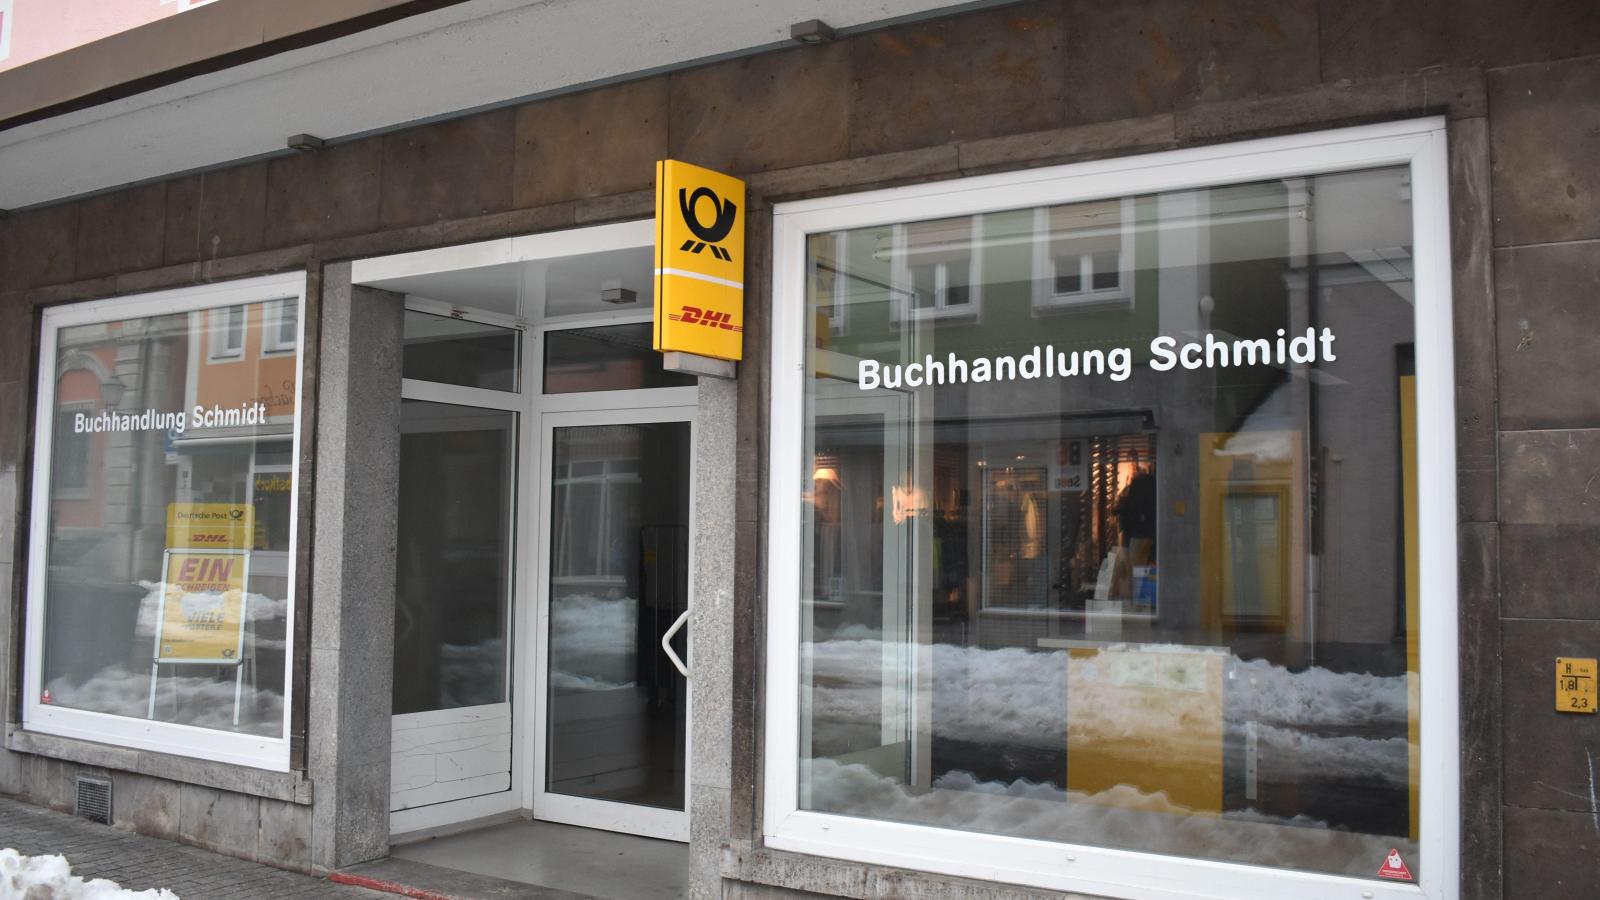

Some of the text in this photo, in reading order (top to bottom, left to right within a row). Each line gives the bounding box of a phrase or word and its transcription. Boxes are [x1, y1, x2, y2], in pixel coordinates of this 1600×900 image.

[681, 306, 734, 331] DHL
[858, 327, 1337, 390] Buchhandlung Schmidt
[74, 402, 266, 433] Buchhandlung Schmidt
[177, 511, 227, 520] Deutsche Post
[191, 534, 229, 543] DHL
[178, 558, 235, 582] EIN
[1566, 663, 1571, 673] H
